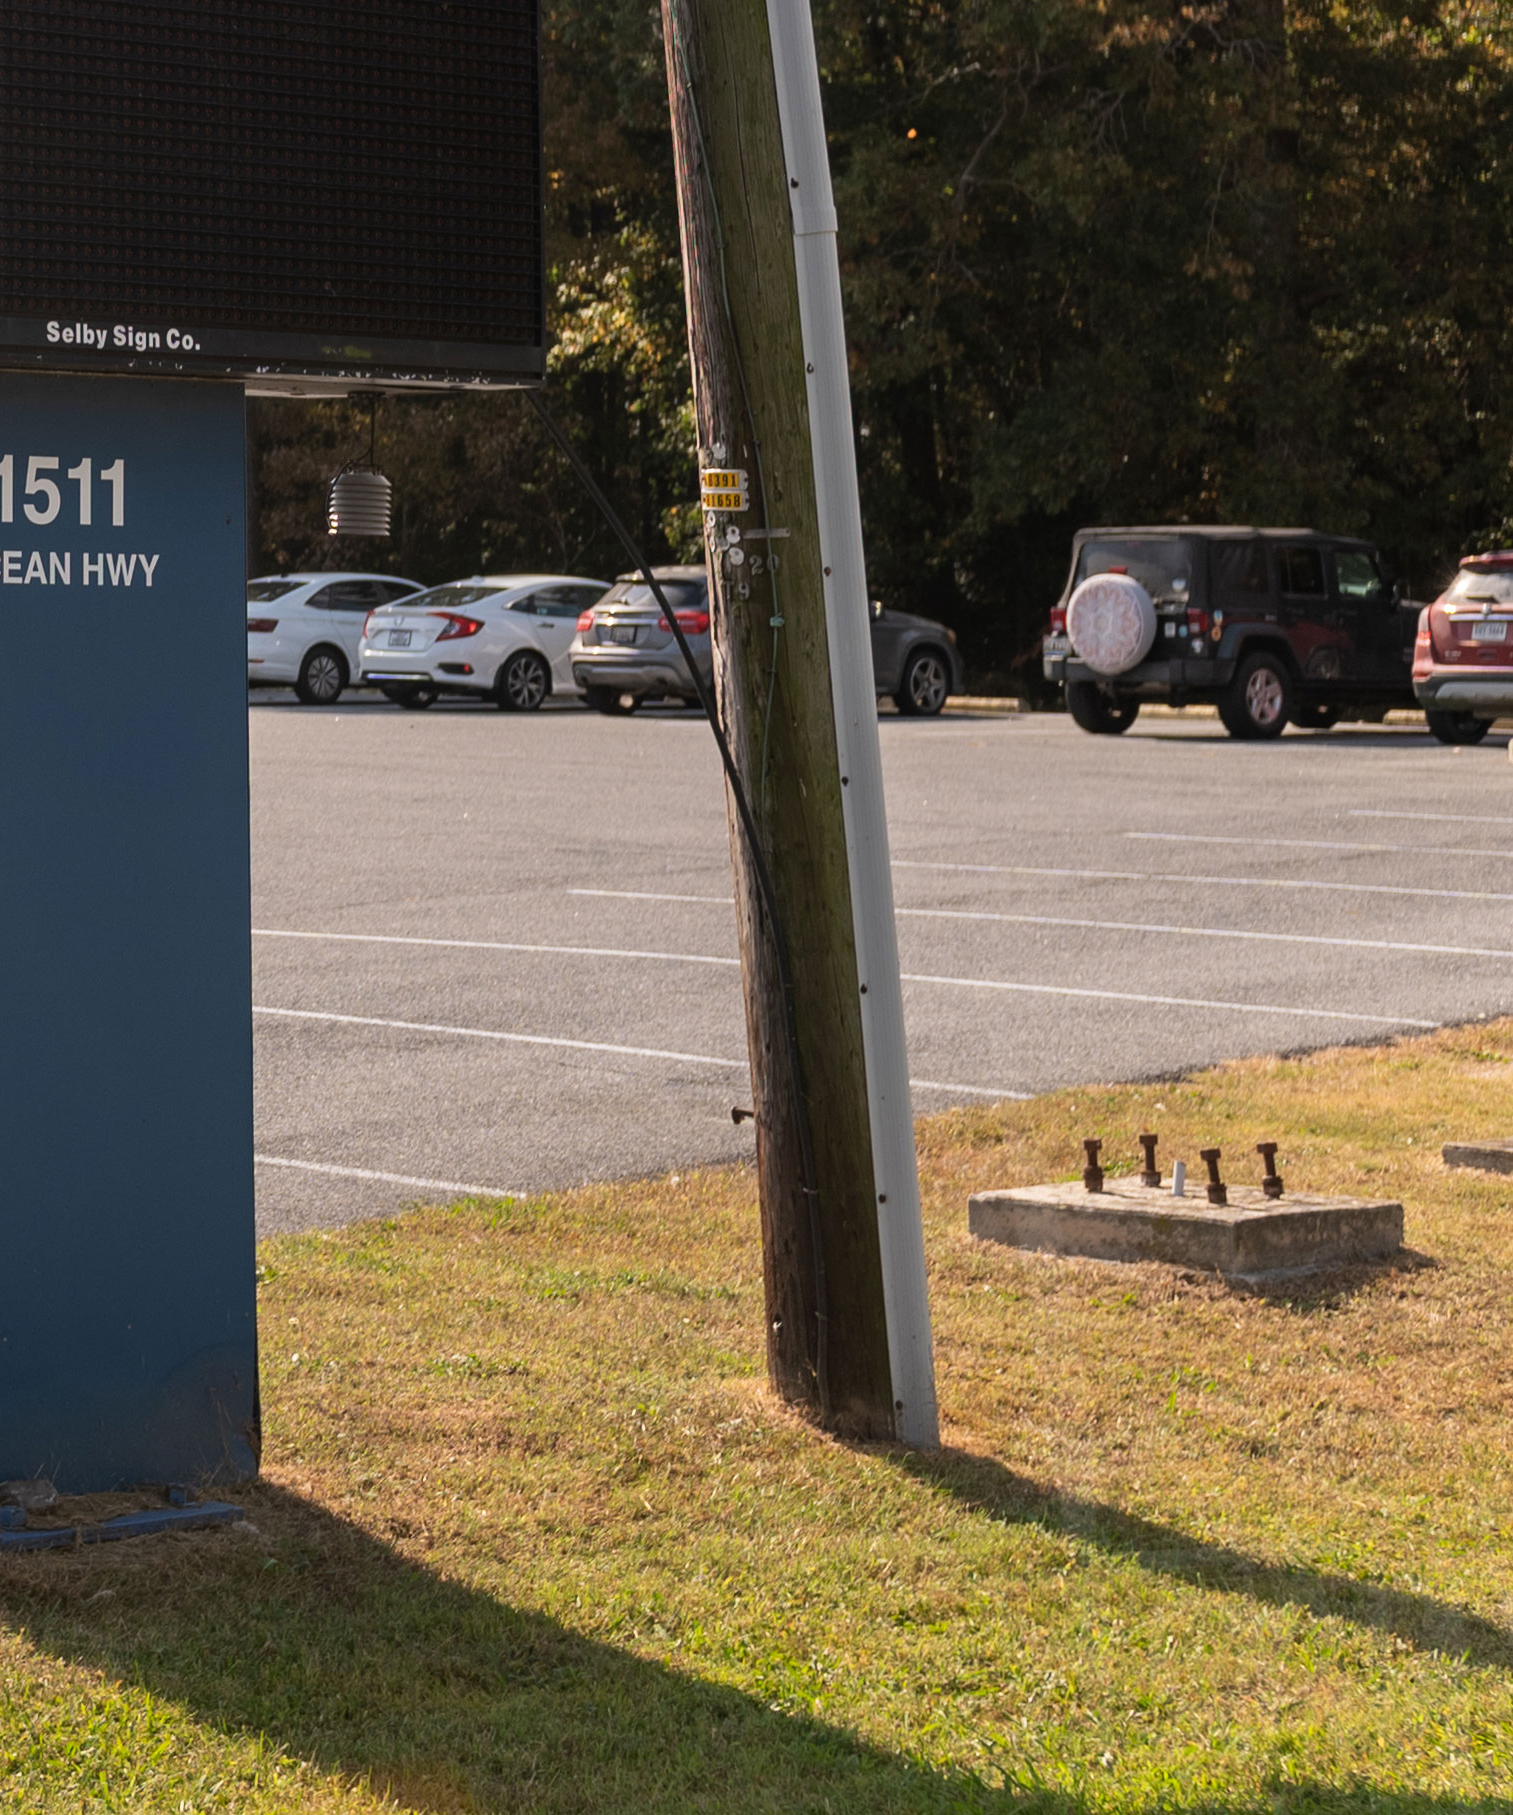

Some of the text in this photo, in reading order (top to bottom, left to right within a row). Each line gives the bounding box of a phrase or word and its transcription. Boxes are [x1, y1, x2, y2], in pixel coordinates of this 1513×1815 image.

[45, 320, 201, 353] Selby Sign Co.
[81, 551, 161, 588] HWY
